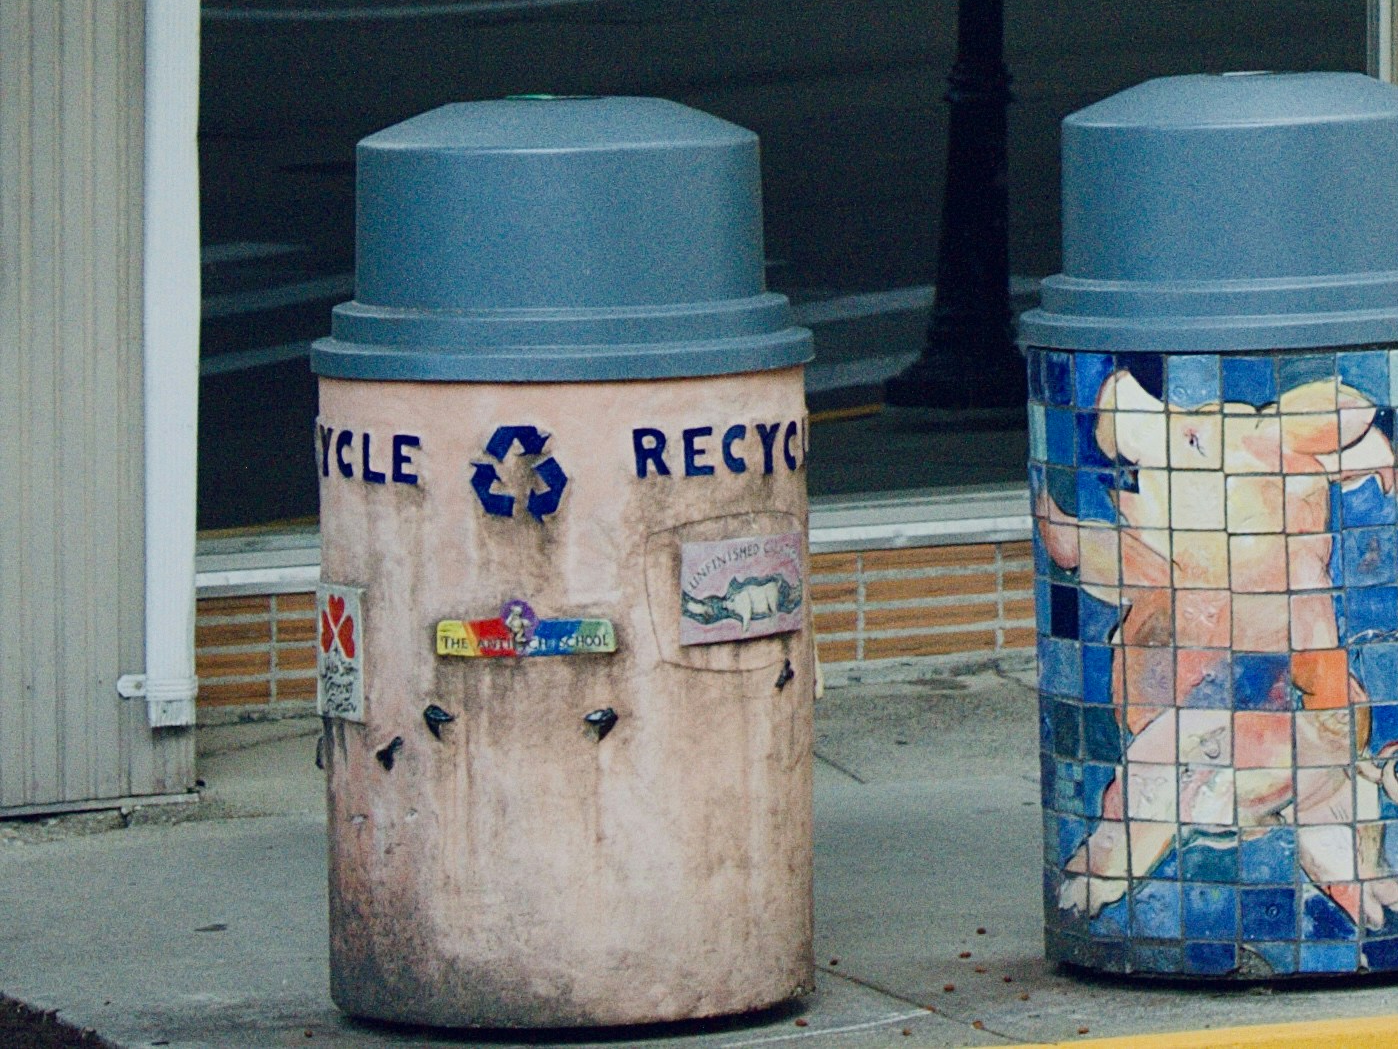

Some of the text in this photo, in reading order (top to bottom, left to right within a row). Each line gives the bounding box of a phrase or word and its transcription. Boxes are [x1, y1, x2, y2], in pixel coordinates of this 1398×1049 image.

[688, 543, 760, 590] UNFINISHED
[441, 636, 469, 650] THE
[558, 633, 609, 649] SCHOOL
